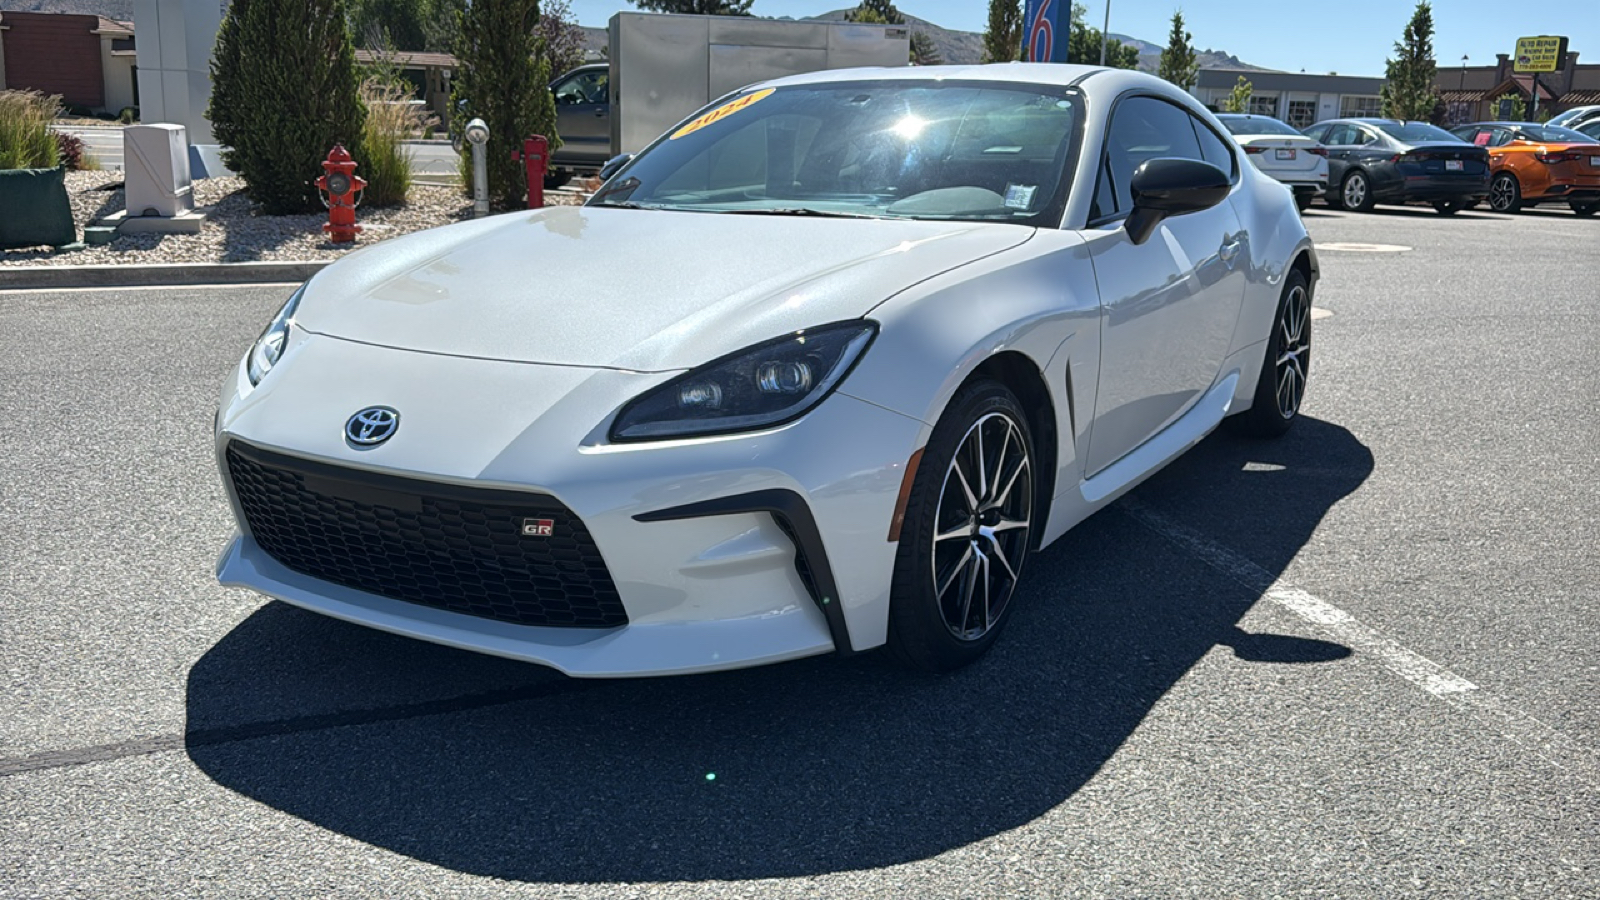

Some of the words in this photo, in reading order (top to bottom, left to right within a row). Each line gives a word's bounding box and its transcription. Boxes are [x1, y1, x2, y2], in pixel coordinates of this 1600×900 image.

[1029, 0, 1052, 62] 6
[686, 94, 754, 133] 2024
[524, 524, 551, 535] GR
